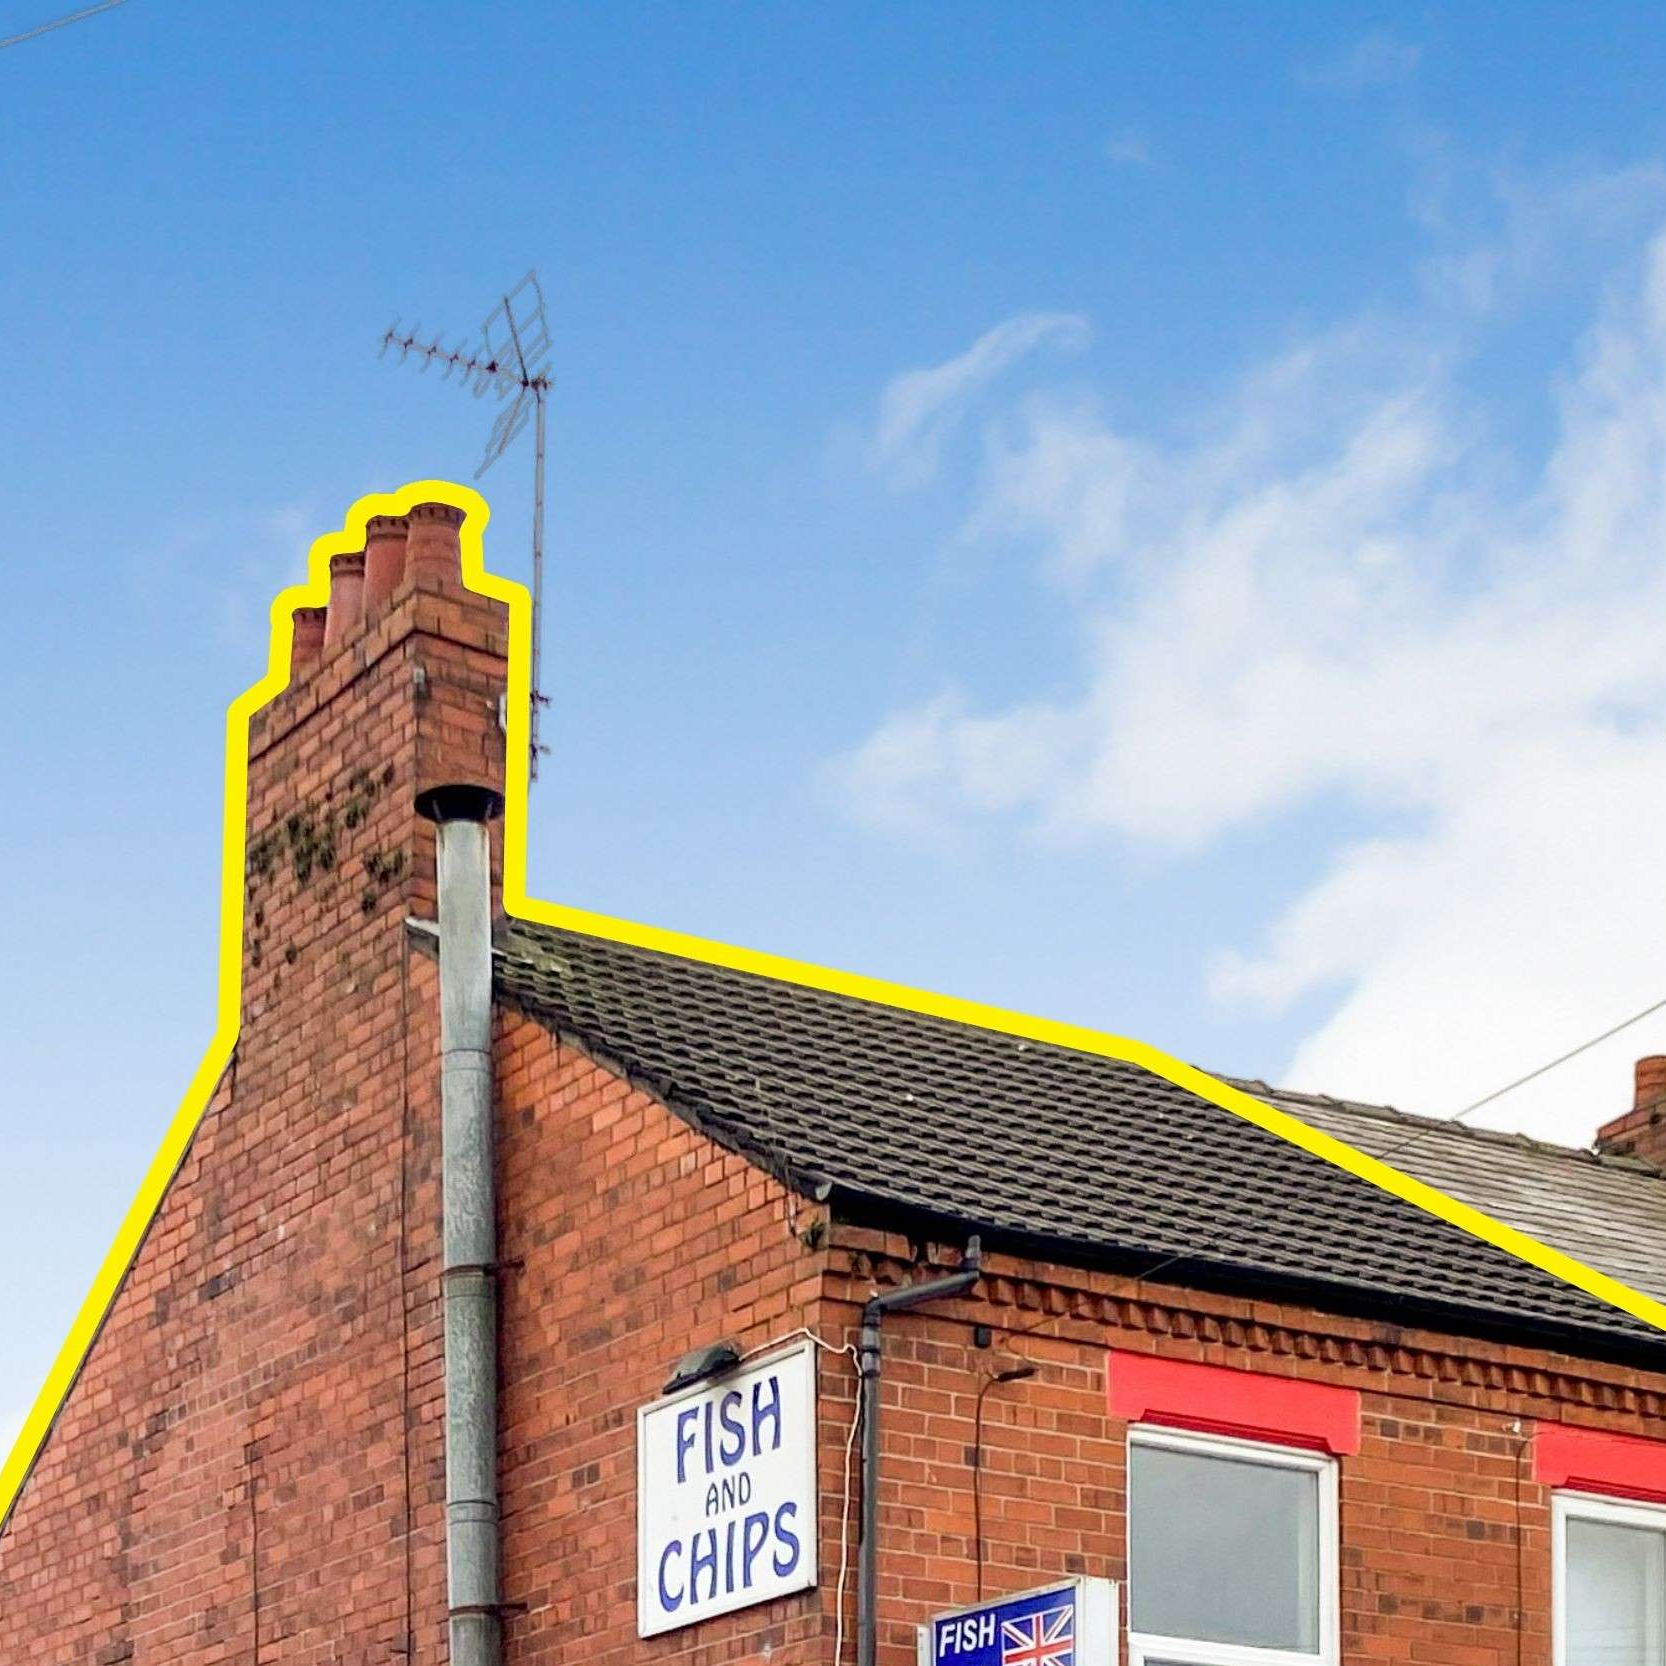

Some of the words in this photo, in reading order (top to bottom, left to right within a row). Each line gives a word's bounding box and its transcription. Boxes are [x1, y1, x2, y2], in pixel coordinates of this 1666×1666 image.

[676, 1375, 781, 1484] FISH
[705, 1471, 751, 1518] AND
[658, 1501, 800, 1612] CHIPS
[939, 1613, 996, 1657] FISH
